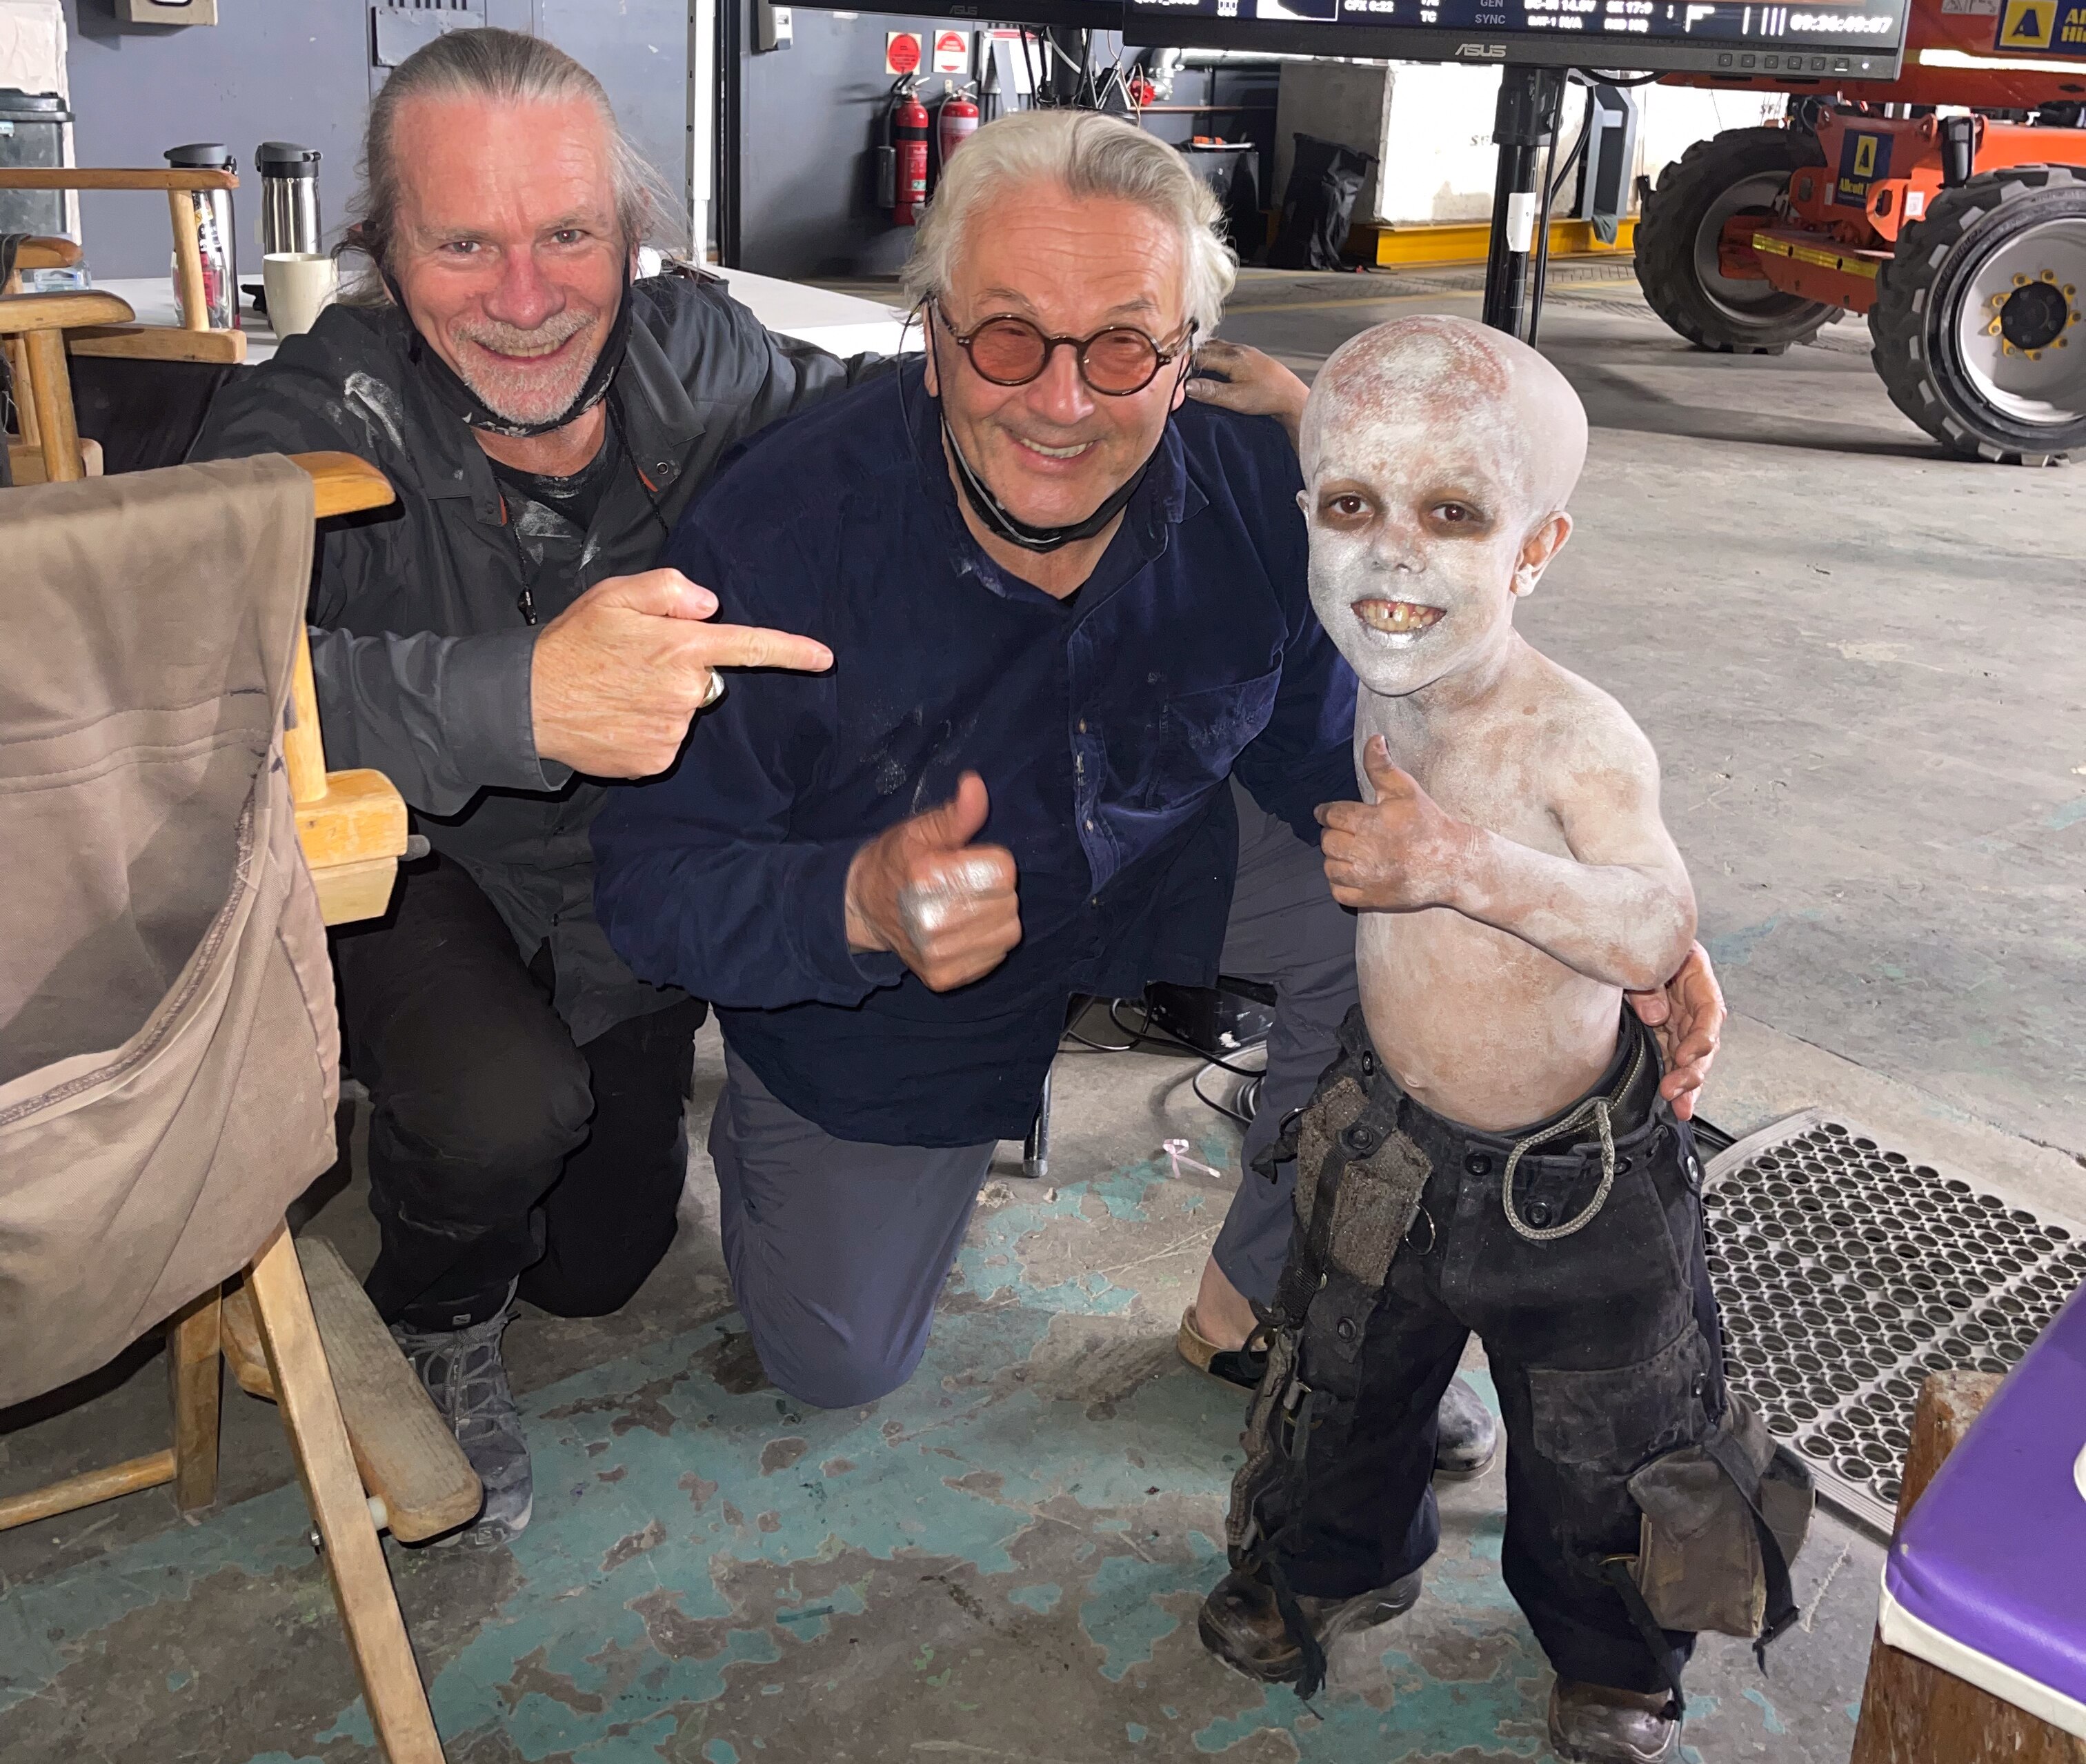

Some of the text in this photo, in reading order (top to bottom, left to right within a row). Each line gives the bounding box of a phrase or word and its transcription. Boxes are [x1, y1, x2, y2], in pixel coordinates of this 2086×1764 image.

[949, 5, 978, 15] ASUS
[1420, 10, 1437, 22] TC
[1475, 14, 1506, 24] SYNC
[1455, 43, 1507, 58] ASUS
